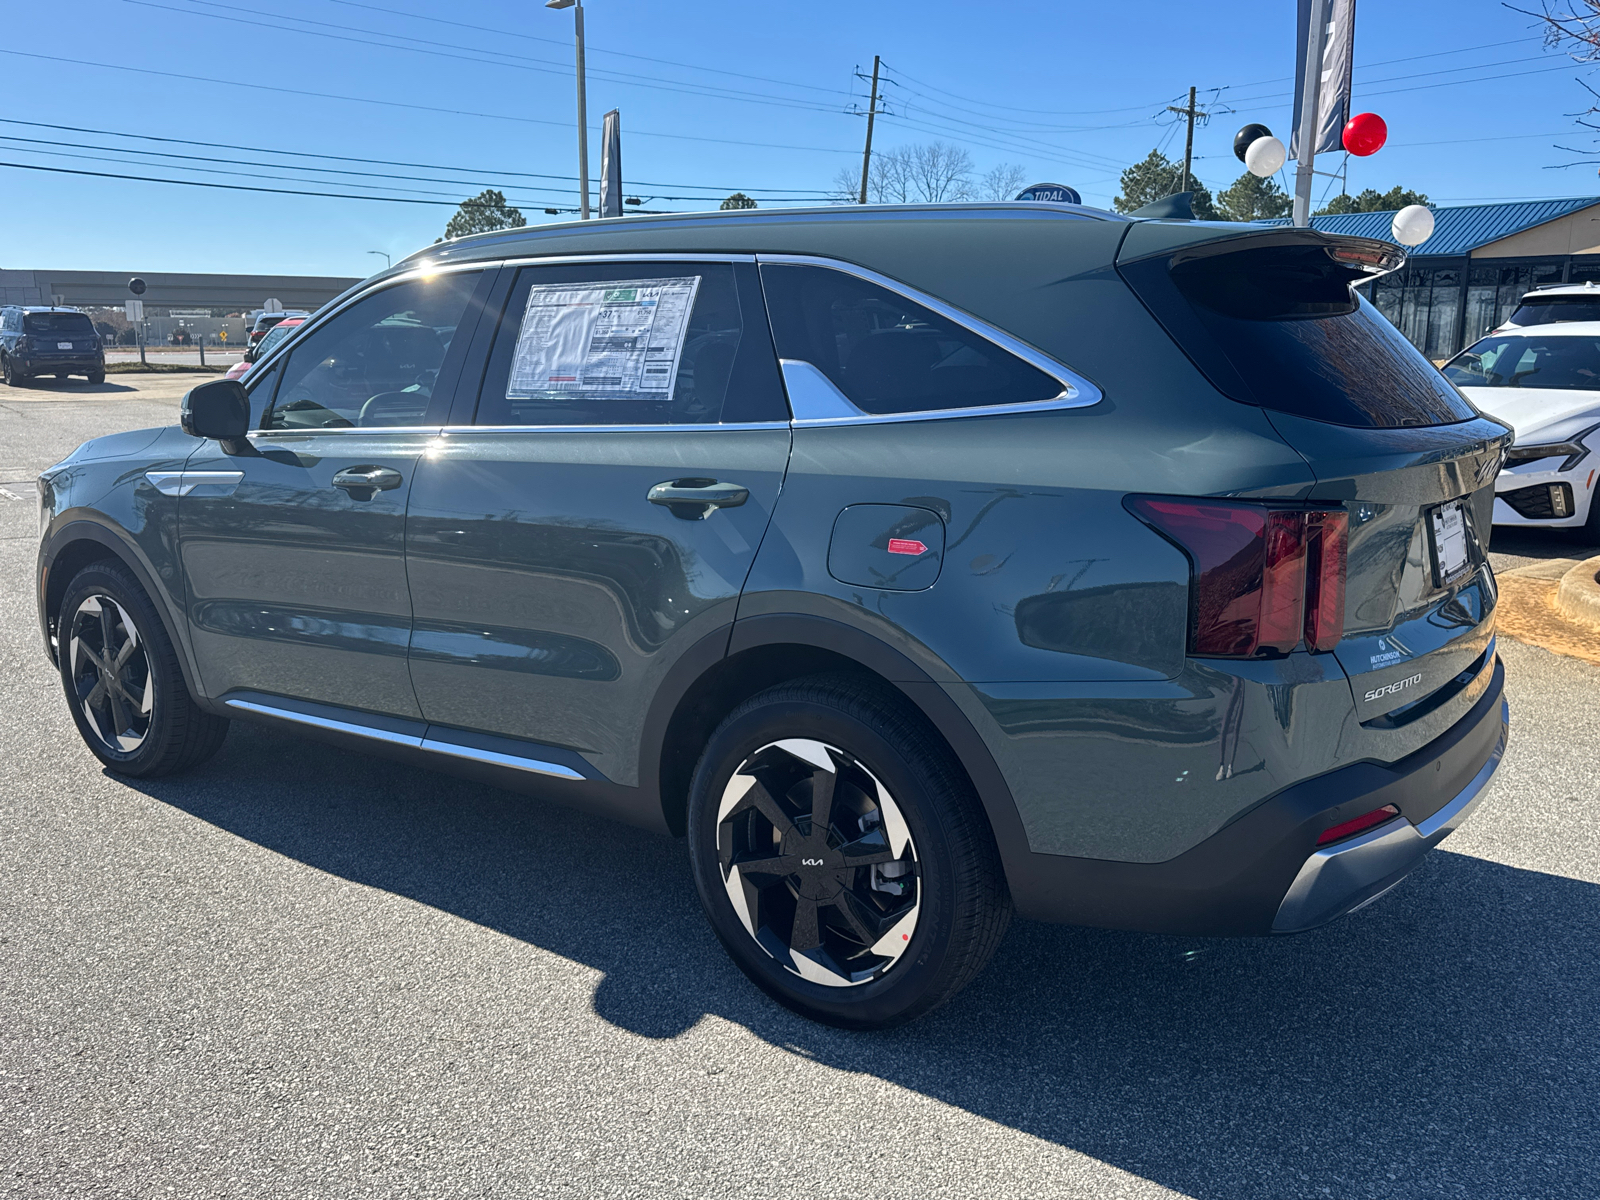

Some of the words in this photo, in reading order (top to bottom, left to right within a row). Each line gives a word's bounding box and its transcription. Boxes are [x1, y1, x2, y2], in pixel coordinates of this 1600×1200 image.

[1034, 190, 1063, 201] TIDAL
[602, 309, 613, 319] 37
[1370, 651, 1401, 664] HUTCHINSON
[1364, 673, 1422, 702] SORENTO
[801, 858, 824, 866] KIA
